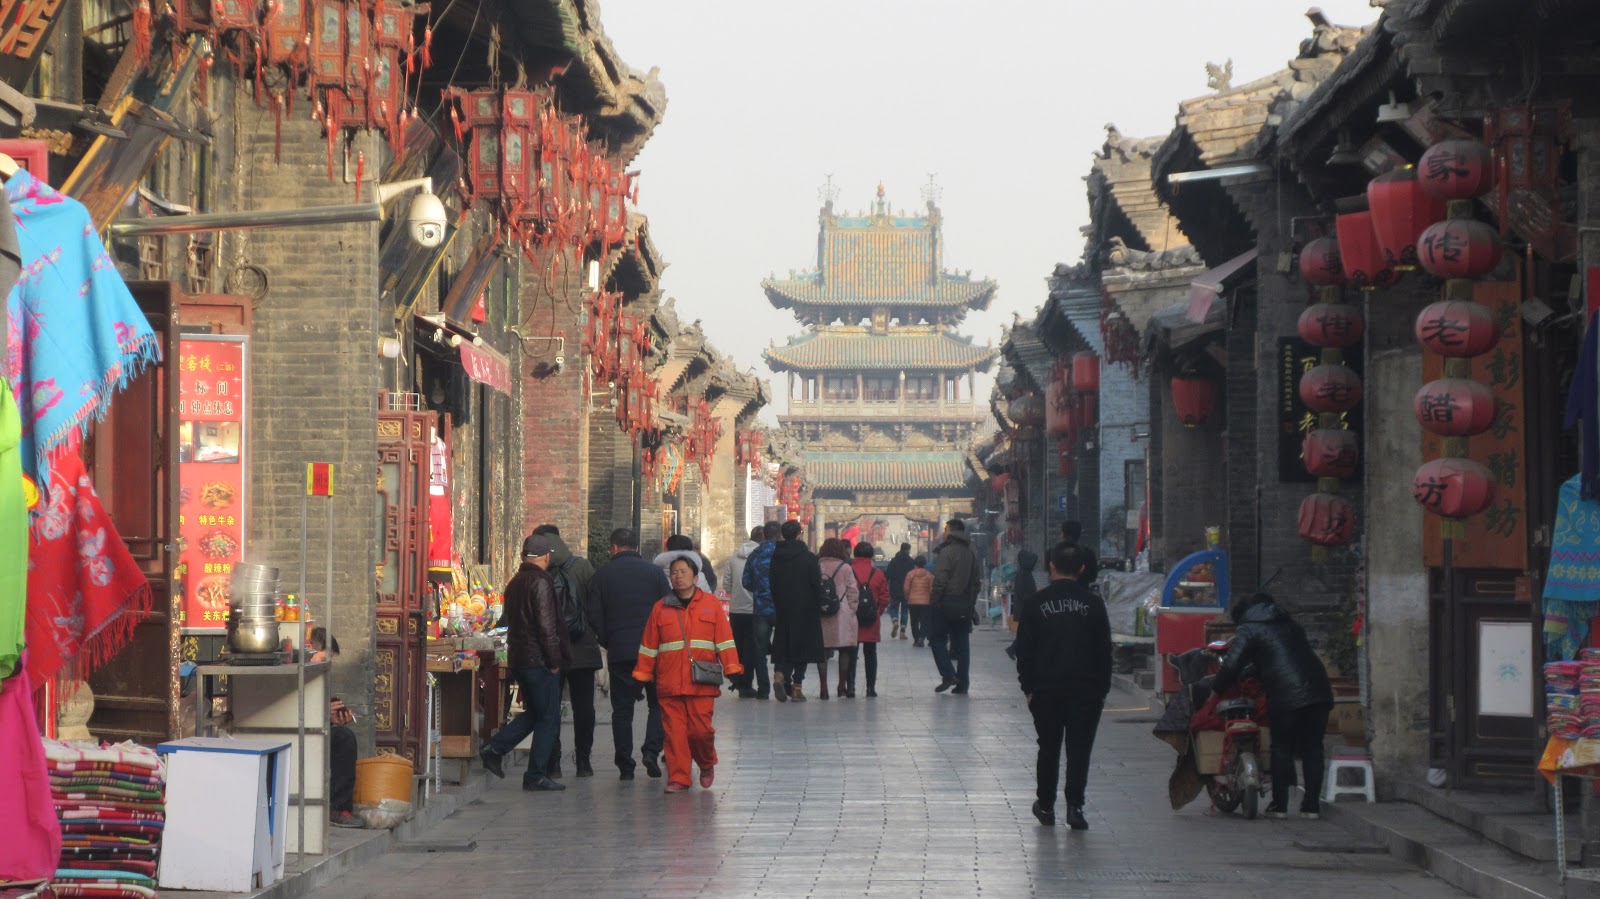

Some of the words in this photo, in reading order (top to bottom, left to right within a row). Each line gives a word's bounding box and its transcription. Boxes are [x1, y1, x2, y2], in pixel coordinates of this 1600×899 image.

[191, 401, 233, 414] 钟点休息
[199, 515, 235, 526] 特色牛杂
[204, 563, 231, 574] 酸辣粉
[203, 610, 230, 621] 关东煮
